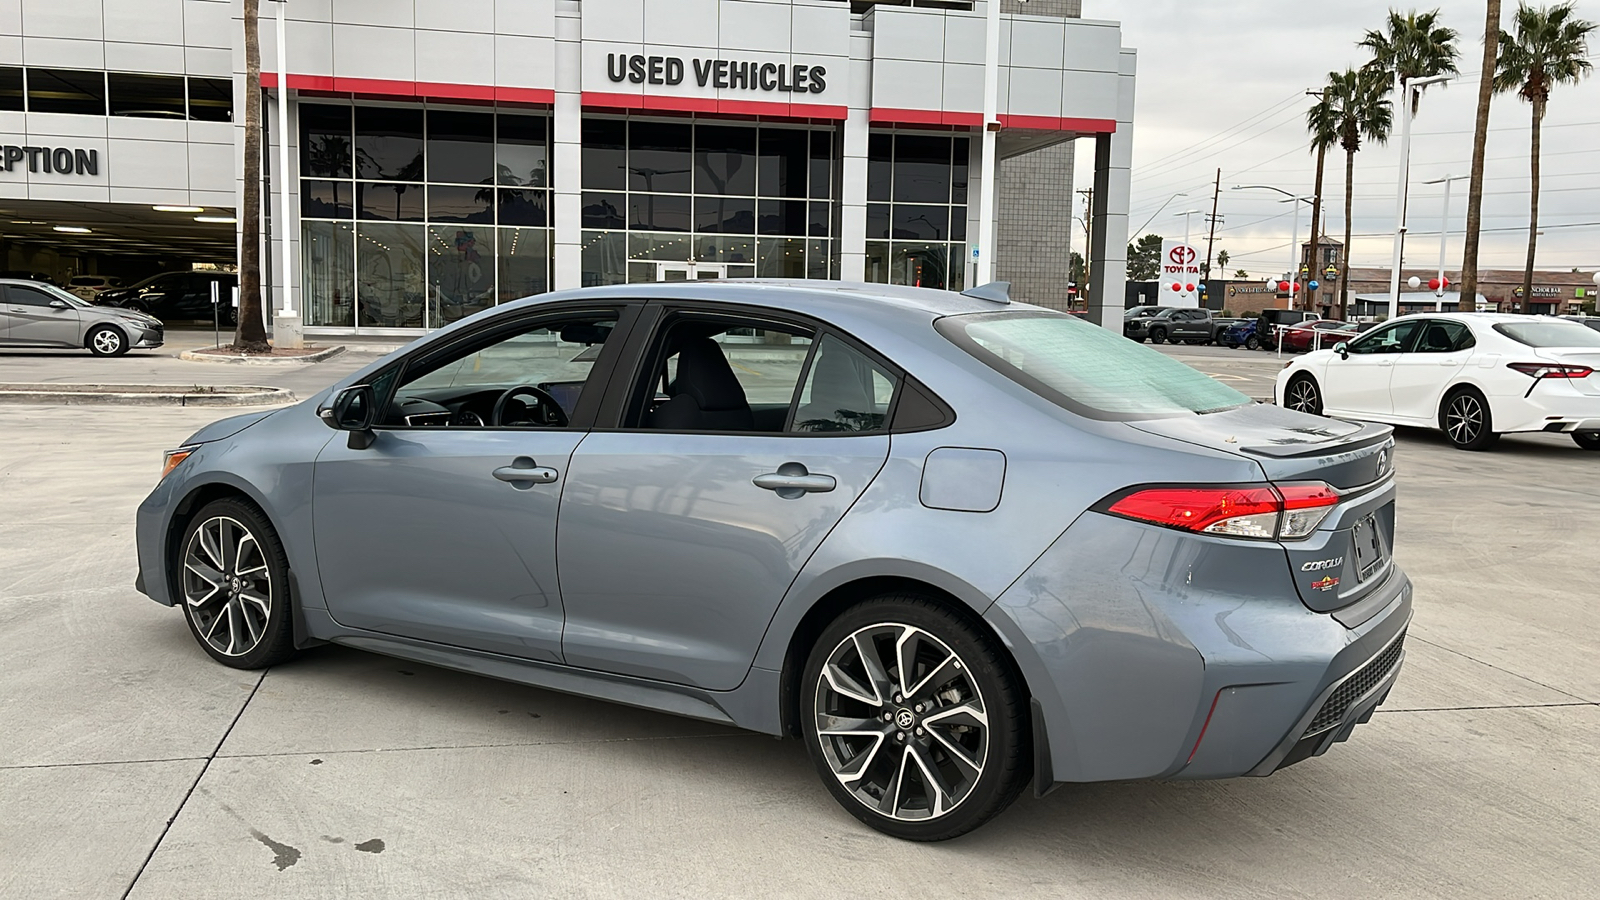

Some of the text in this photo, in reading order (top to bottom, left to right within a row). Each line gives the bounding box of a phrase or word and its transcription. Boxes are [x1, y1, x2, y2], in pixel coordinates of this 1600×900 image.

[607, 53, 827, 94] USED VEHICLES
[0, 145, 98, 176] PTION
[1301, 556, 1343, 572] COROLLA
